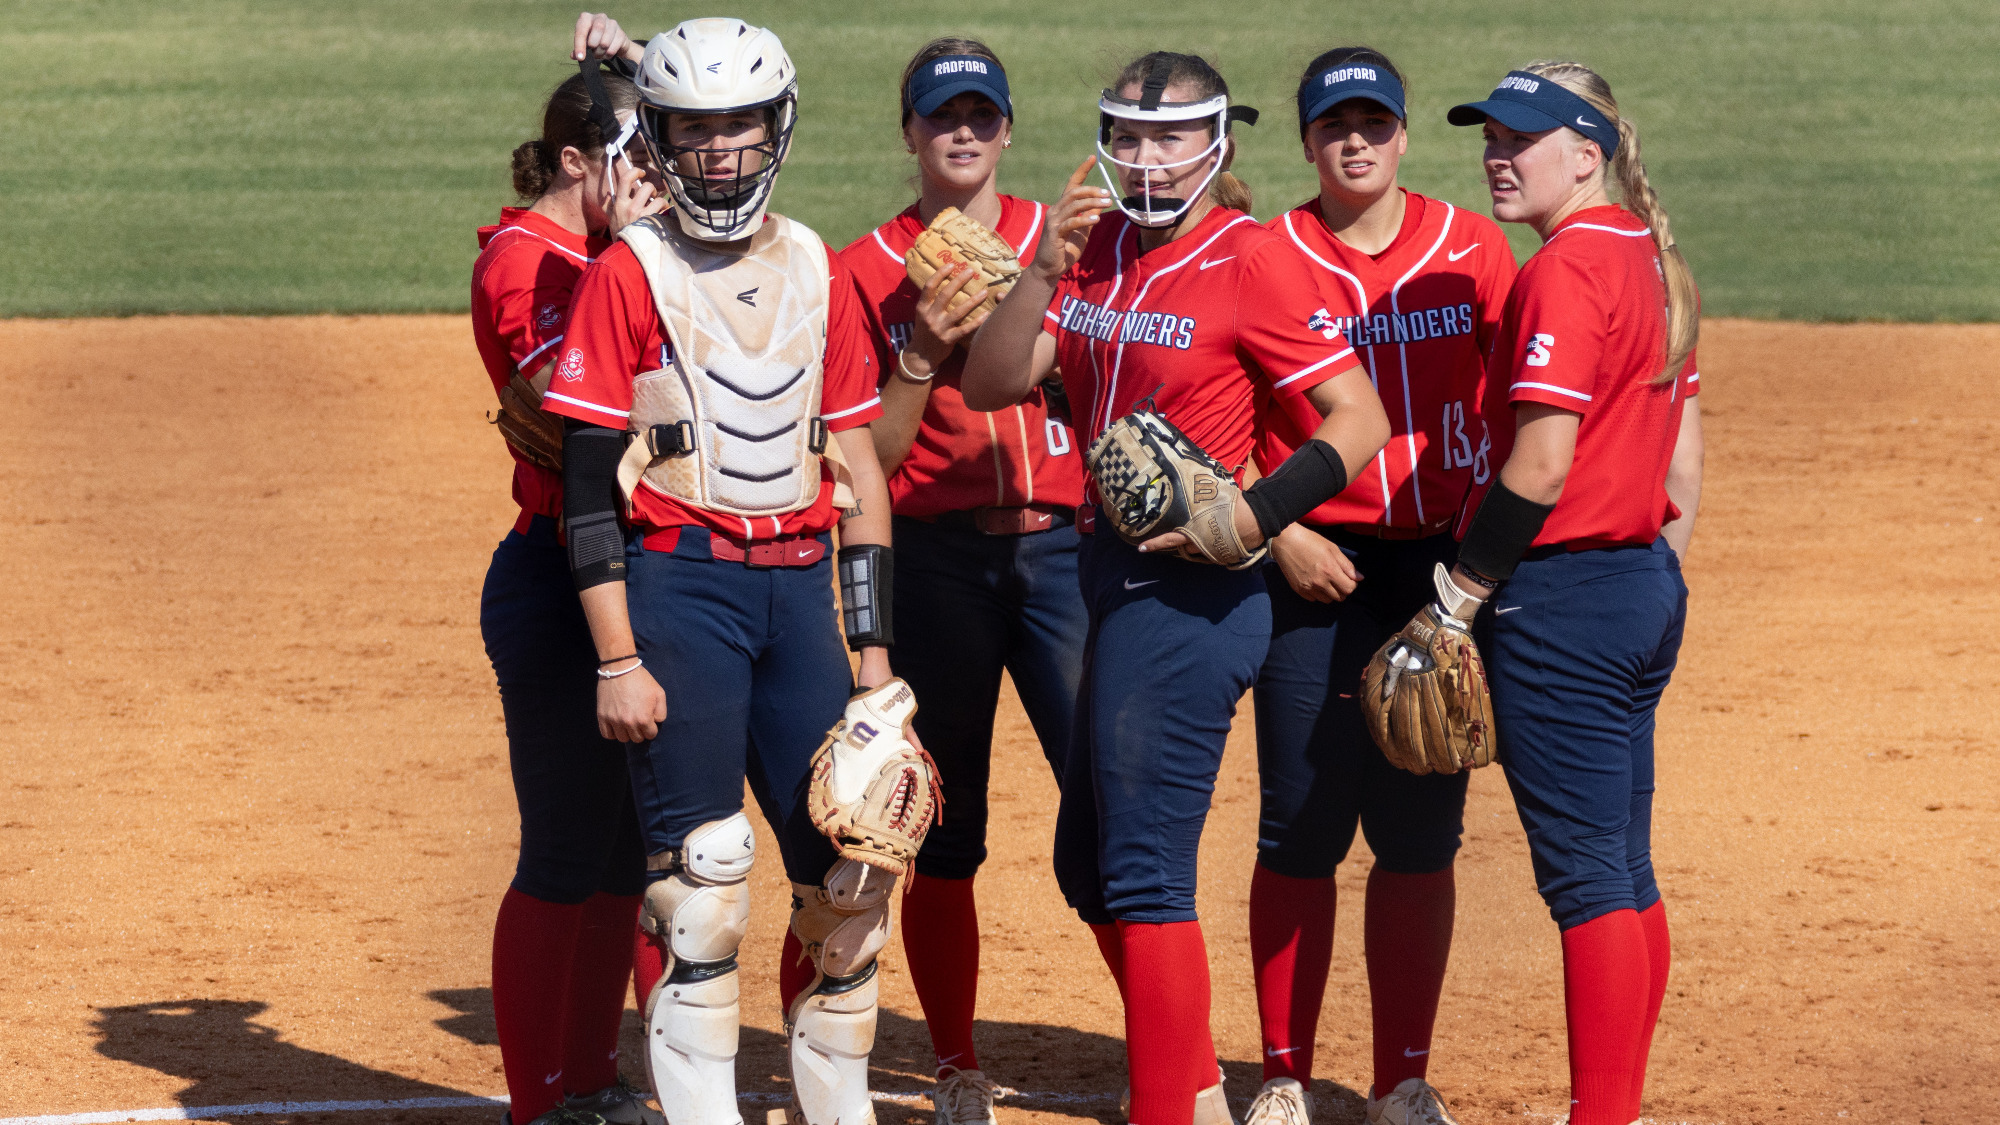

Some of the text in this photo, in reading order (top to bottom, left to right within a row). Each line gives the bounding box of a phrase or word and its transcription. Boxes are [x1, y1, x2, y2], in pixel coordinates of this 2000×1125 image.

[934, 60, 988, 76] RADFORD
[1324, 67, 1377, 87] RADFORD
[1496, 76, 1540, 94] ADFORD
[1442, 399, 1474, 471] 13
